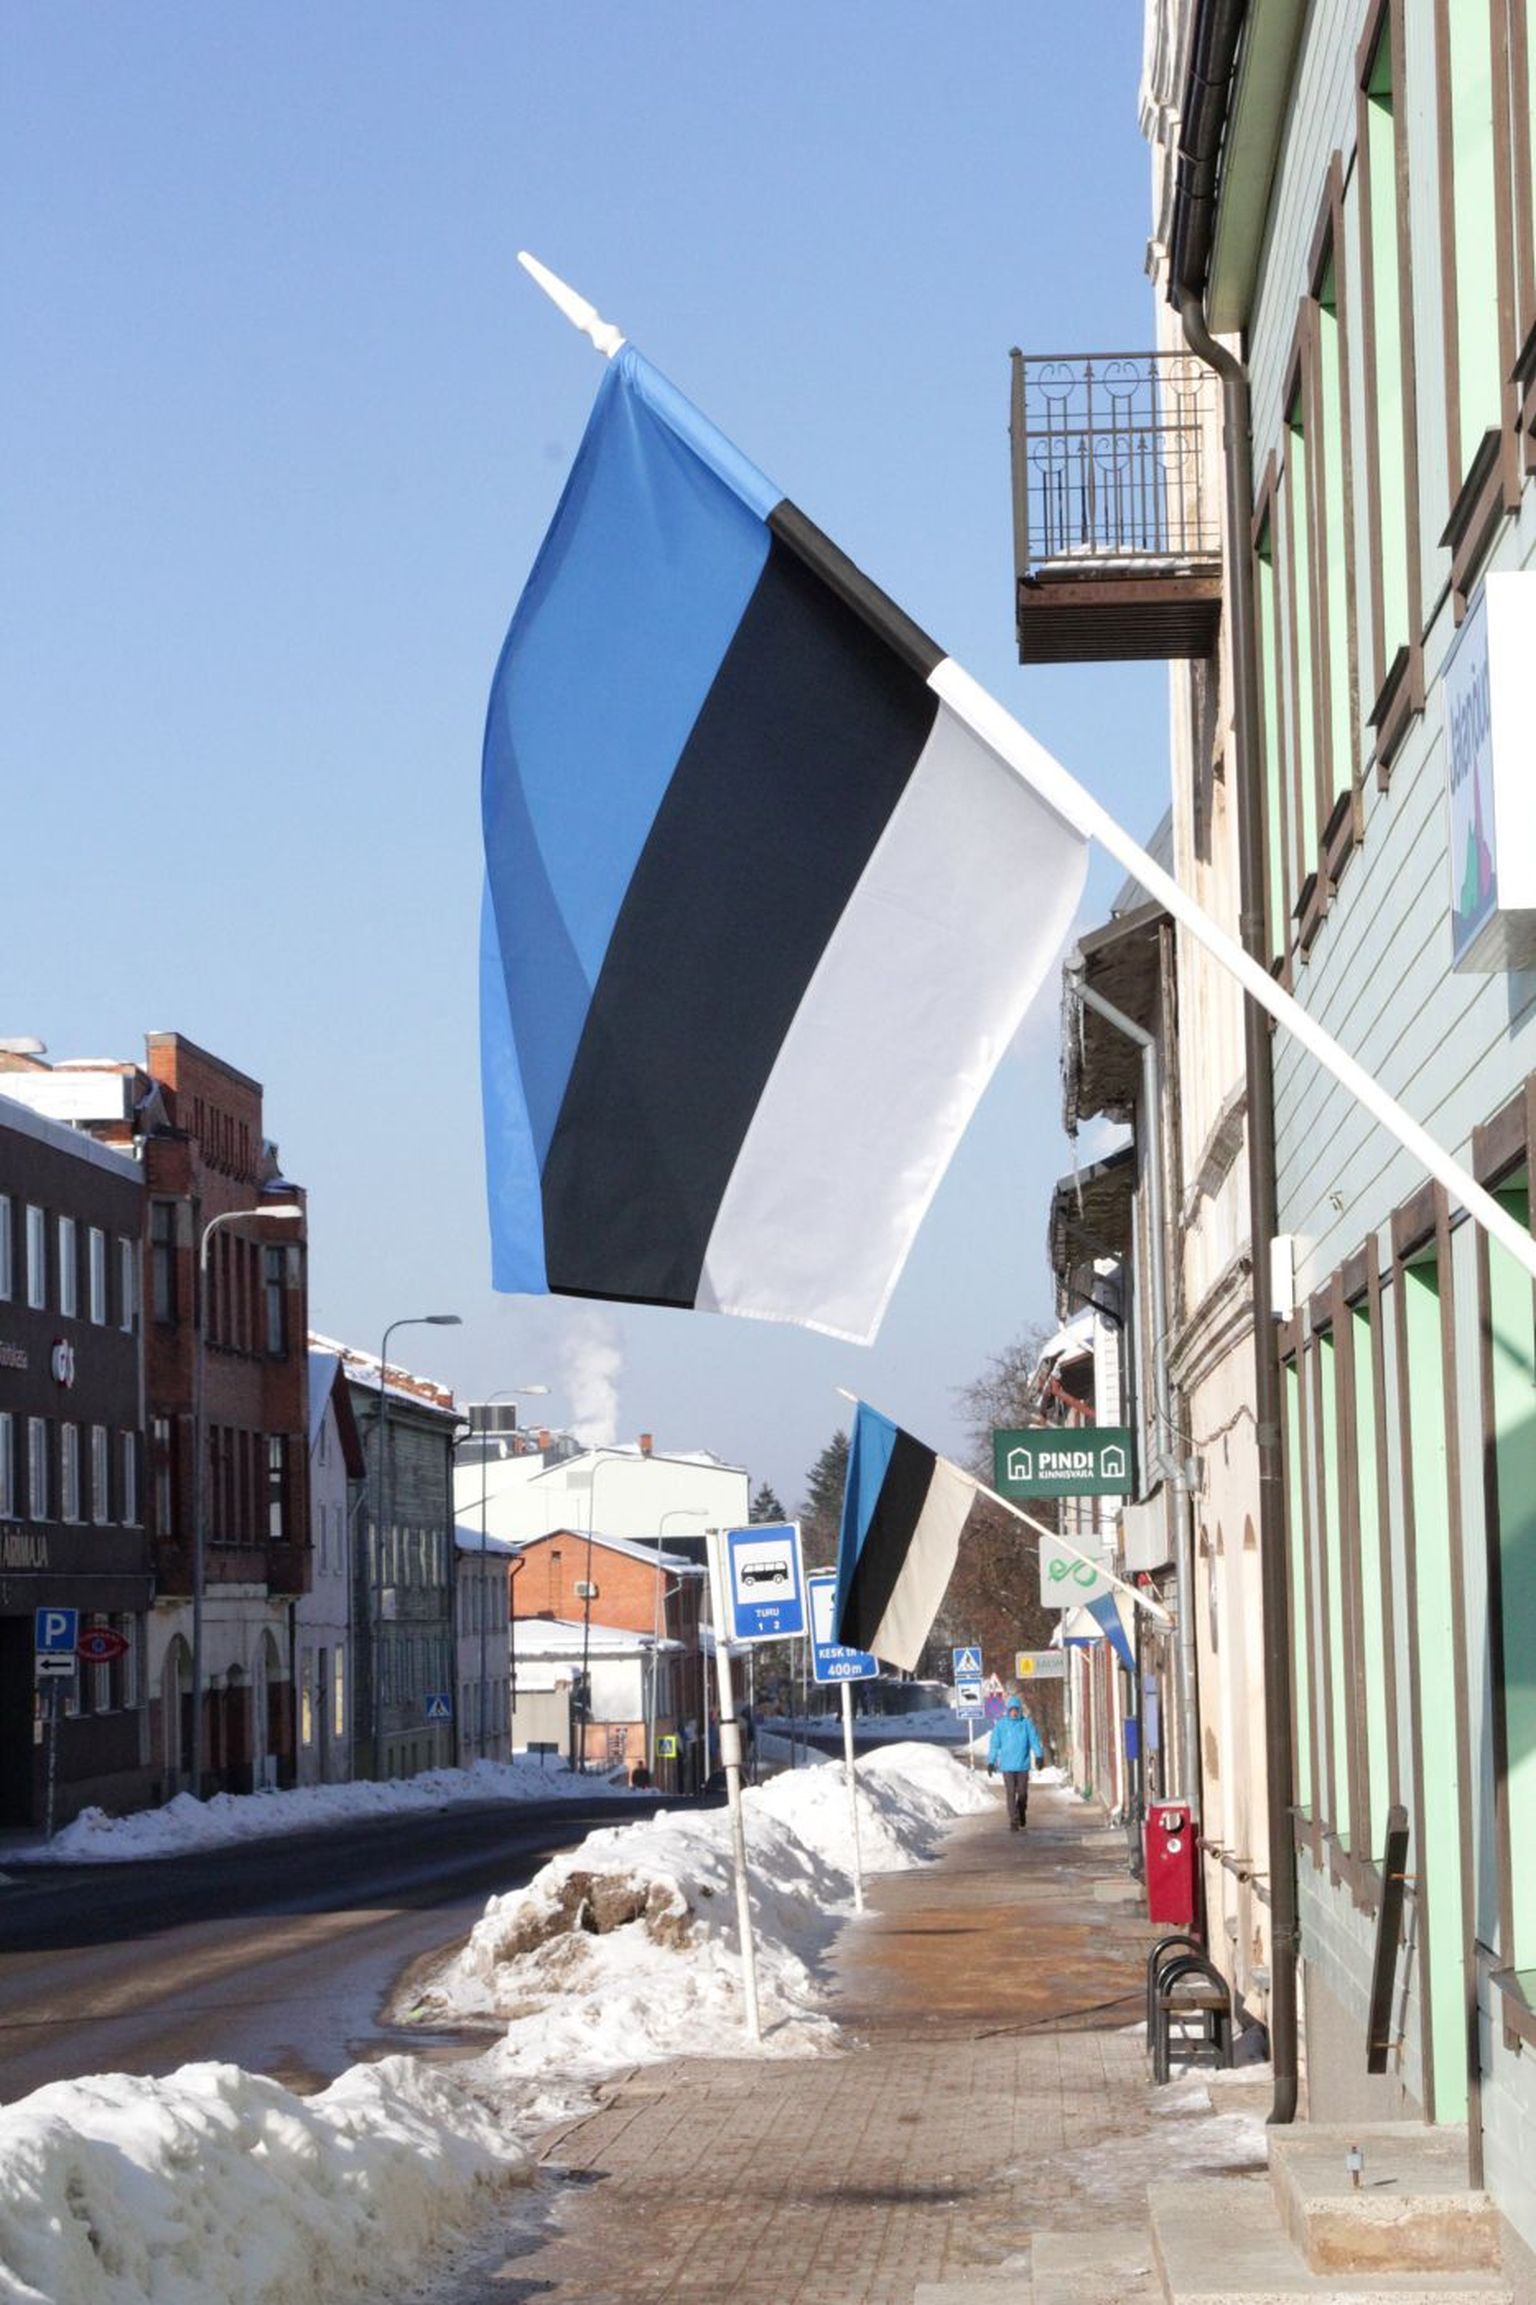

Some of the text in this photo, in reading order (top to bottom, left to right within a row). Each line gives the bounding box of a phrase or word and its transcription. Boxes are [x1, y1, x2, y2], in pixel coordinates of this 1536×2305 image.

[1038, 1451, 1094, 1470] PINDI
[1038, 1469, 1095, 1479] KINNISVARA
[45, 1612, 66, 1646] P
[819, 1647, 844, 1659] KESK
